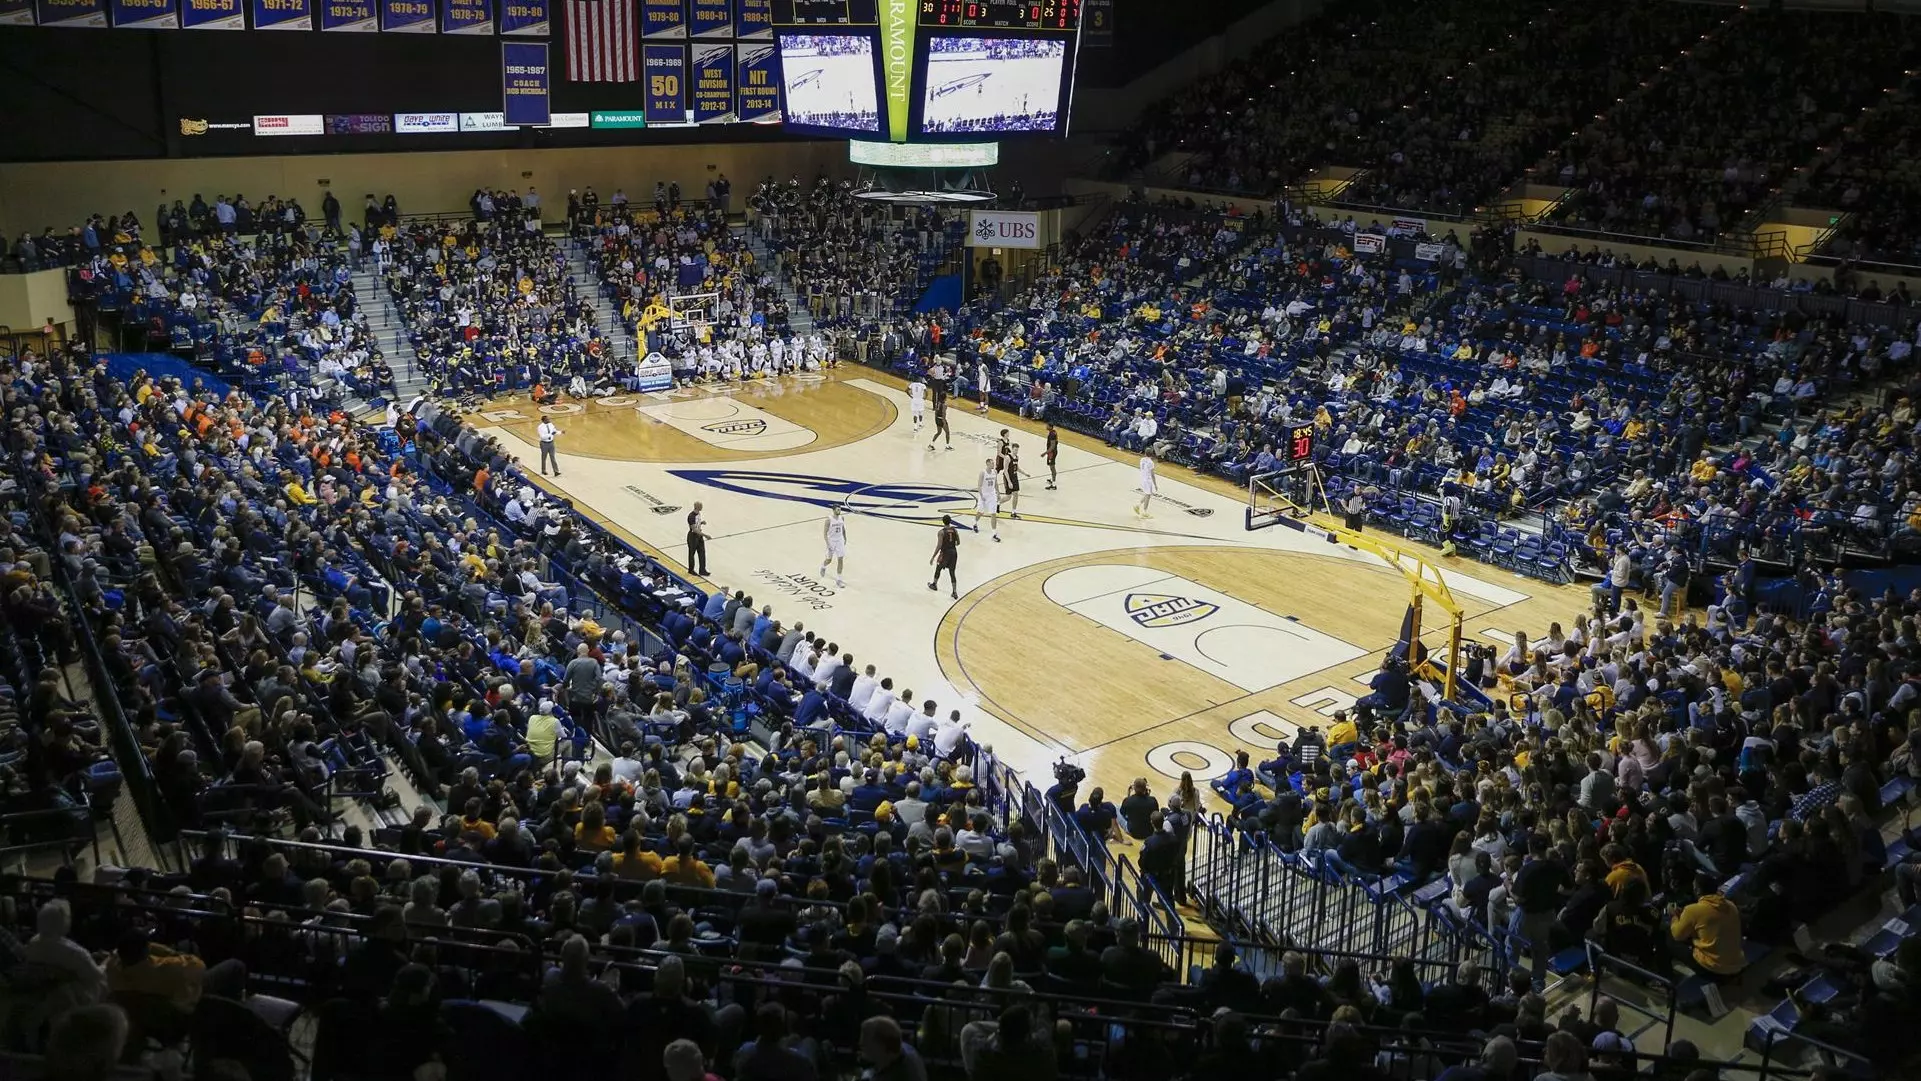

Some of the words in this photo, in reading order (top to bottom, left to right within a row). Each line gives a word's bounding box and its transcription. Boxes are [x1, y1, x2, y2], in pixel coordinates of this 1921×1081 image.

[190, 0, 234, 10] 1966-67
[263, 0, 303, 10] 1971-72
[390, 3, 428, 14] 1978-79
[923, 2, 934, 12] 30
[330, 5, 368, 17] 1973-74
[450, 9, 485, 20] 1978-79
[507, 6, 543, 17] 1979-80
[696, 10, 727, 20] 1980-81
[968, 4, 977, 17] 0
[981, 7, 987, 18] 3
[1019, 9, 1025, 18] 3
[1031, 7, 1040, 20] 0
[1044, 7, 1054, 17] 25
[648, 11, 679, 21] 1979-80
[703, 69, 722, 79] WEST
[749, 70, 767, 85] NIT
[513, 79, 540, 87] COACH
[651, 75, 678, 97] 50
[699, 79, 727, 89] DIVISION
[740, 87, 757, 96] FIRST
[758, 87, 777, 96] ROUND
[655, 101, 676, 109] MIX
[700, 101, 727, 111] 2012-13
[746, 99, 772, 109] 2013-14
[1000, 222, 1035, 239] UBS
[1293, 437, 1309, 458] 30
[785, 572, 836, 598] COURT
